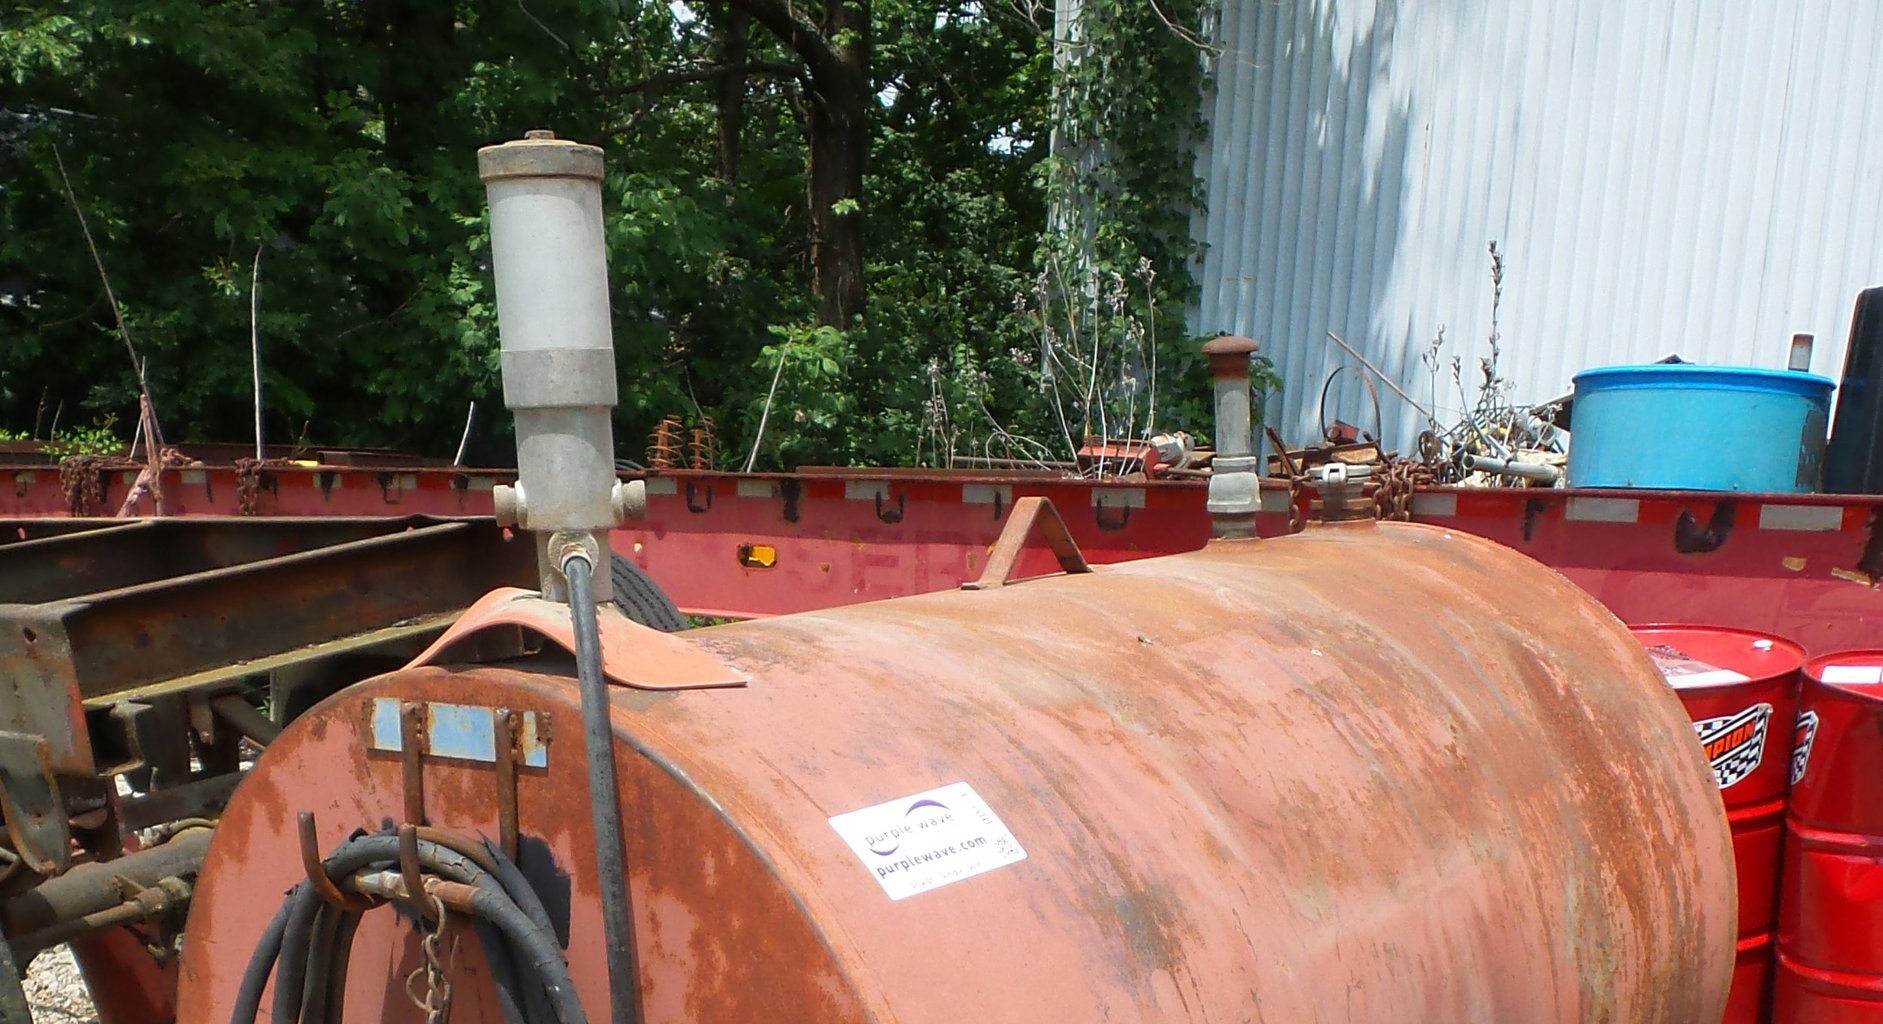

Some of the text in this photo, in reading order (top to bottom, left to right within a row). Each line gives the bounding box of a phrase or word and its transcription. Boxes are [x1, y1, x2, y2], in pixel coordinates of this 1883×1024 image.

[864, 813, 956, 847] purple wave
[876, 835, 988, 880] purplewave.com
